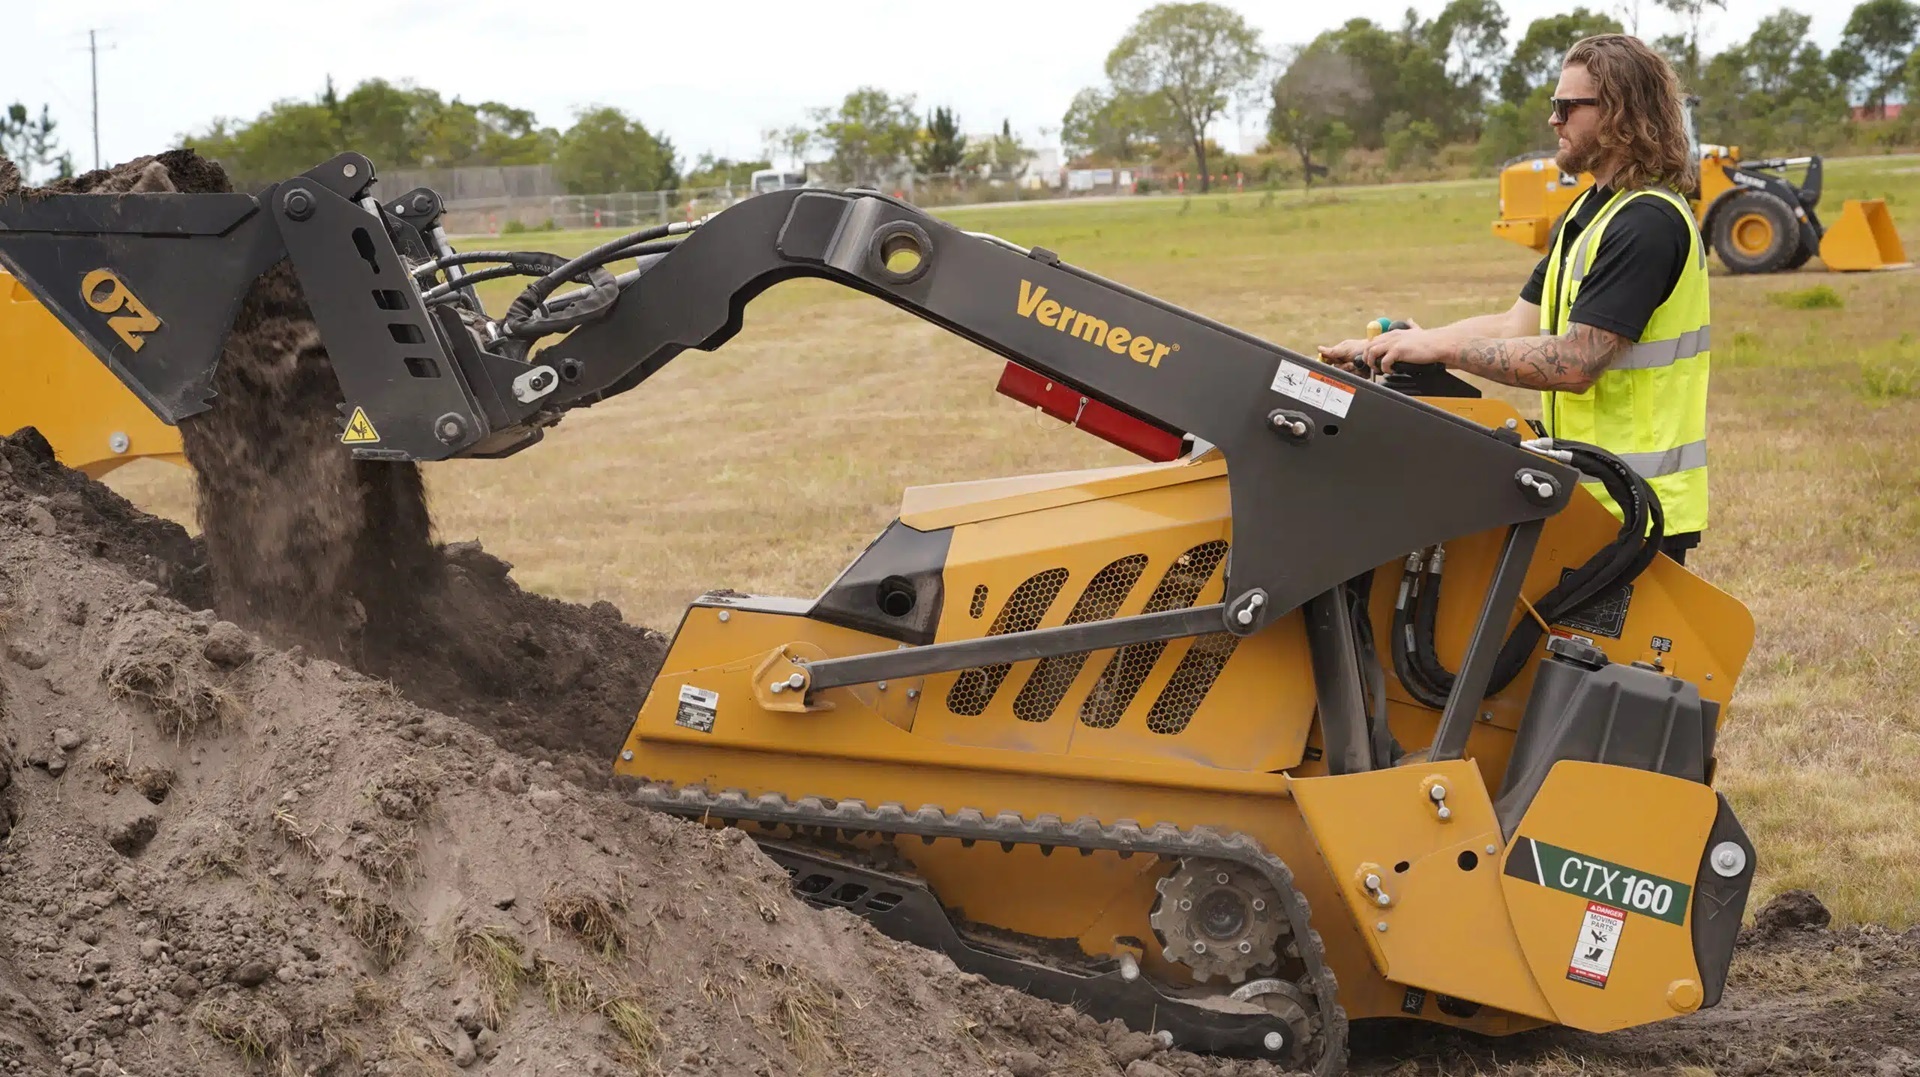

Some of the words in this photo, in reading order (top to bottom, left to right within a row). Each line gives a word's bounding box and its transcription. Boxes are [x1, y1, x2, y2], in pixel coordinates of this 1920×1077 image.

[81, 269, 161, 353] OZ
[1559, 856, 1673, 915] CTX160
[1596, 906, 1624, 918] DANGER
[1590, 914, 1618, 926] MOVING
[1590, 920, 1614, 932] PARTS
